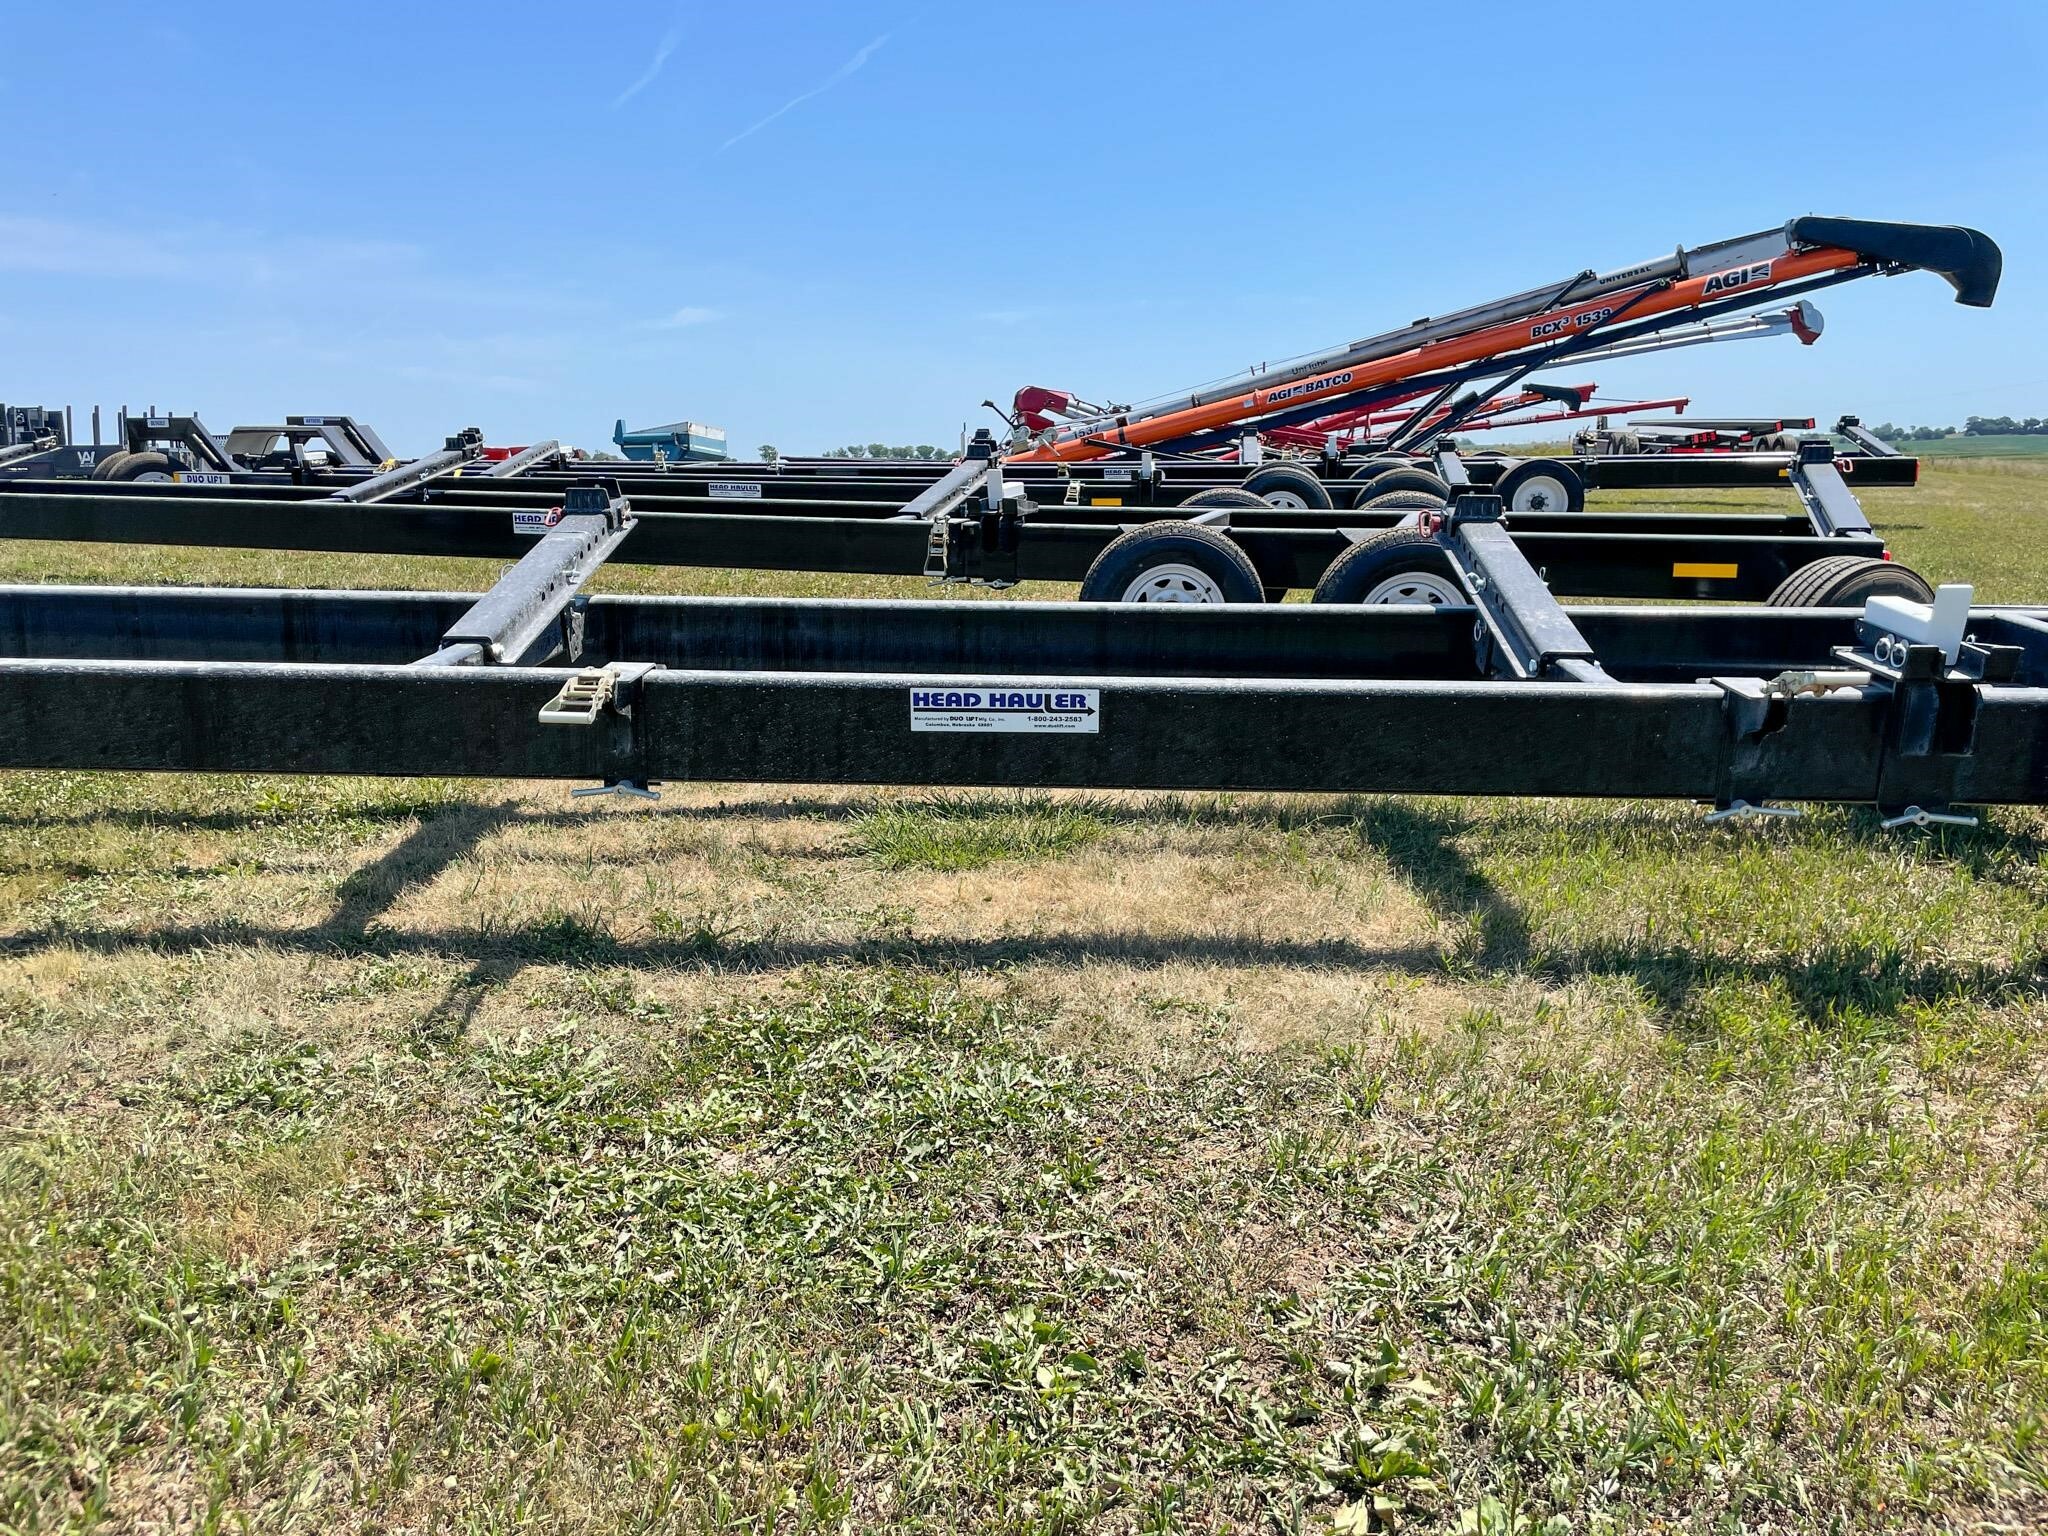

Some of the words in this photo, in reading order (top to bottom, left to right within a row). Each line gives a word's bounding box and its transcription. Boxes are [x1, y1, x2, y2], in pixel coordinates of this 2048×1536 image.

[1600, 266, 1651, 285] UNIVERSAL
[1704, 268, 1748, 295] AGI
[1575, 308, 1612, 326] 1539
[1268, 388, 1292, 402] AGI
[1306, 373, 1352, 392] BATCO
[1074, 425, 1099, 439] 1537
[186, 475, 205, 484] DUO
[514, 514, 542, 523] HEAD
[913, 692, 982, 707] HEAD
[989, 693, 1087, 709] HAULER
